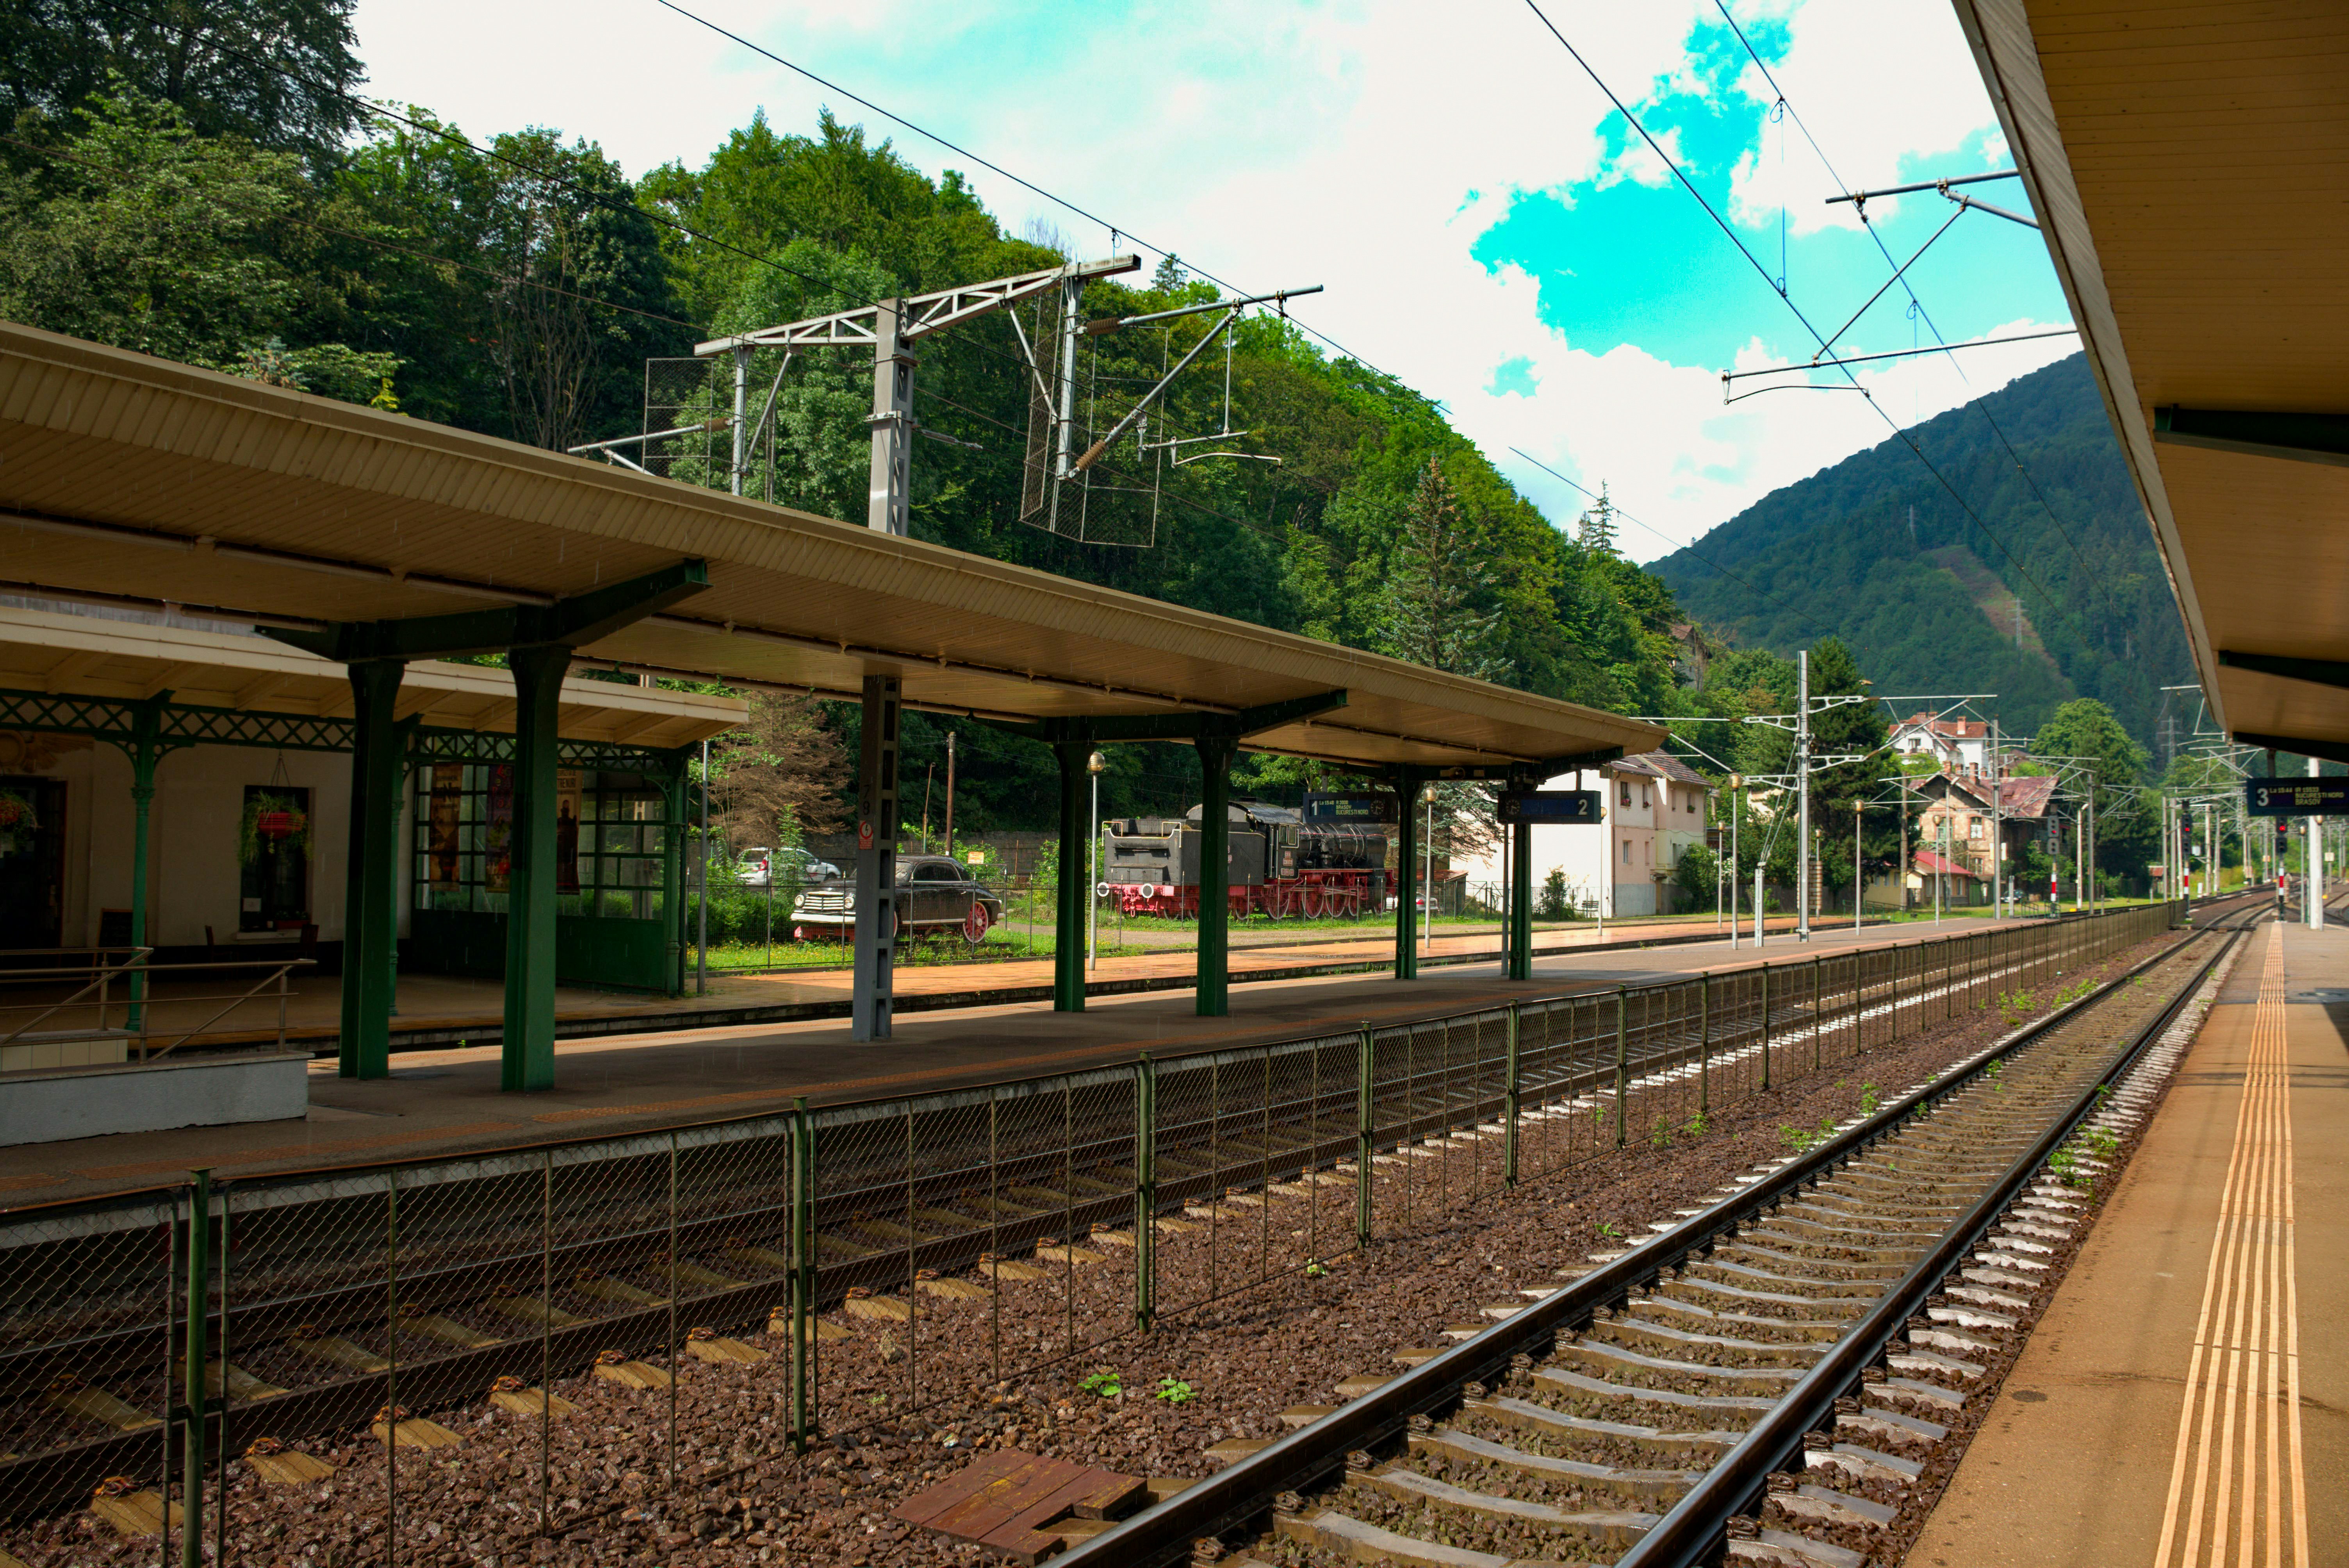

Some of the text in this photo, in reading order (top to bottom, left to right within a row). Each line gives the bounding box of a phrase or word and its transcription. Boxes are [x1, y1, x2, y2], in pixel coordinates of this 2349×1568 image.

[2257, 788, 2269, 807] 3
[1312, 801, 1318, 816] 1
[1578, 799, 1588, 815] 2
